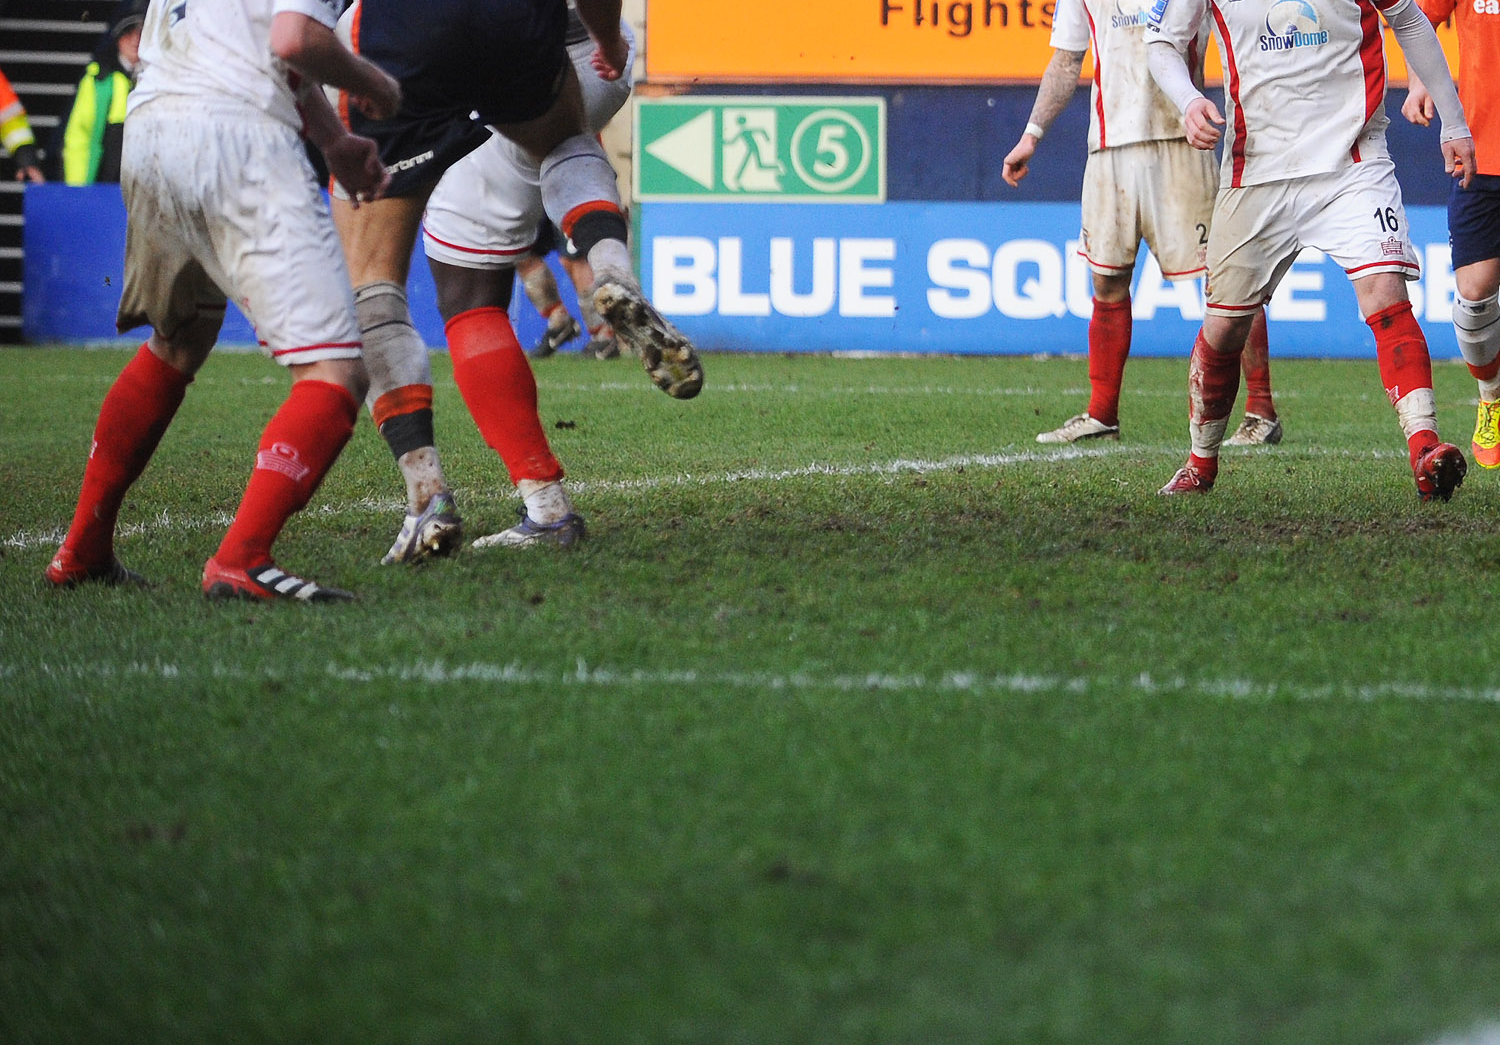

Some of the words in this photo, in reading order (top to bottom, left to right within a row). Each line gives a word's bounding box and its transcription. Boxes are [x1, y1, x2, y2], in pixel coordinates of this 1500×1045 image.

[1260, 30, 1328, 51] SnowDome
[384, 149, 434, 175] arbrini
[812, 125, 849, 179] 5
[1373, 207, 1399, 232] 16
[652, 236, 896, 317] BLUE
[926, 237, 1327, 321] SQAE
